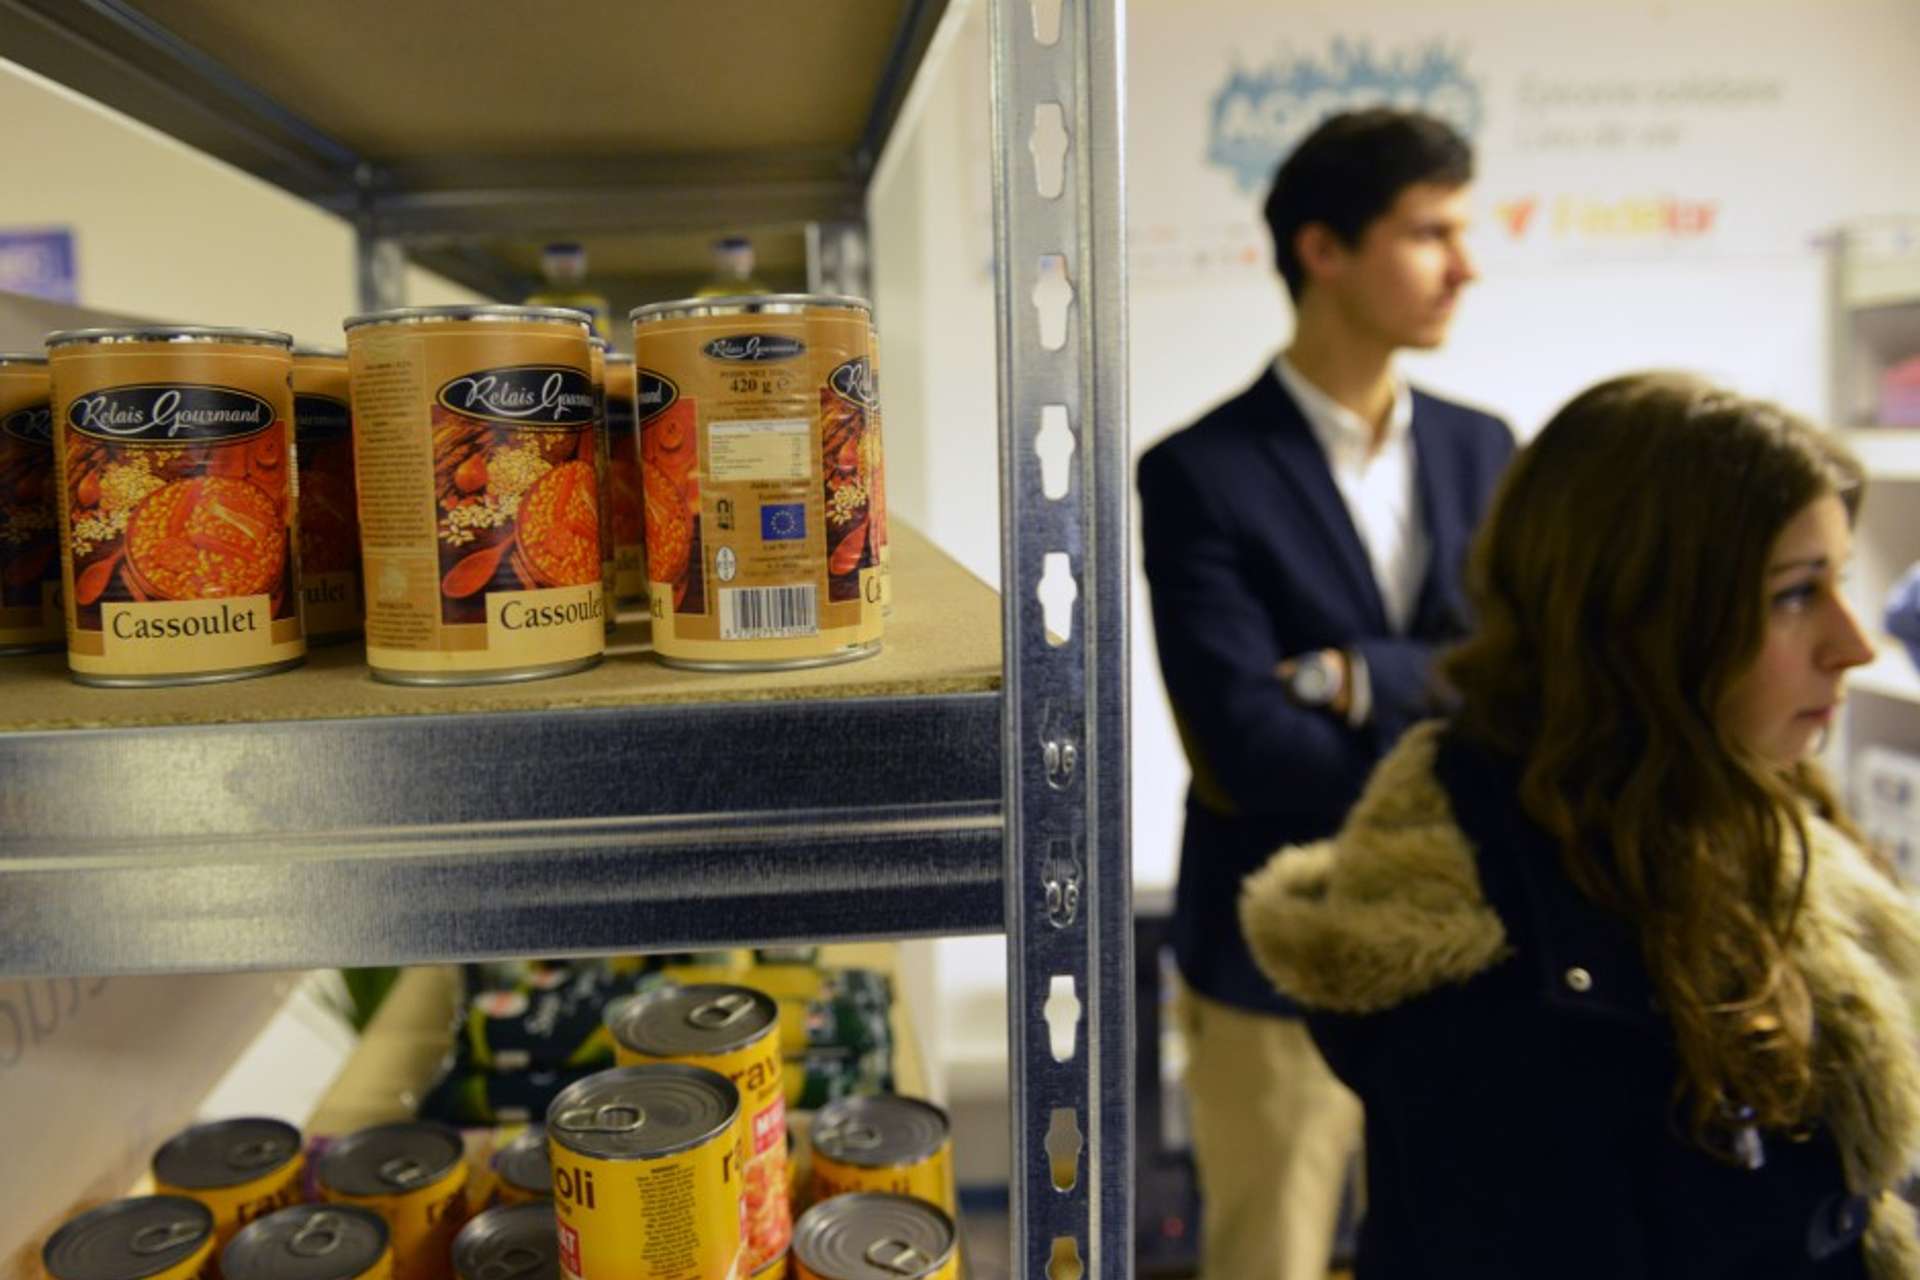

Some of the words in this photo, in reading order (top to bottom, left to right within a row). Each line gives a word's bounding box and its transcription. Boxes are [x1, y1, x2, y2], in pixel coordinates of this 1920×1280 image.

[463, 375, 536, 417] Relais
[730, 378, 758, 393] 420
[82, 396, 146, 433] Relais
[152, 390, 261, 436] Gourmand
[112, 605, 257, 640] Cassoulet
[500, 591, 604, 630] Cassoule
